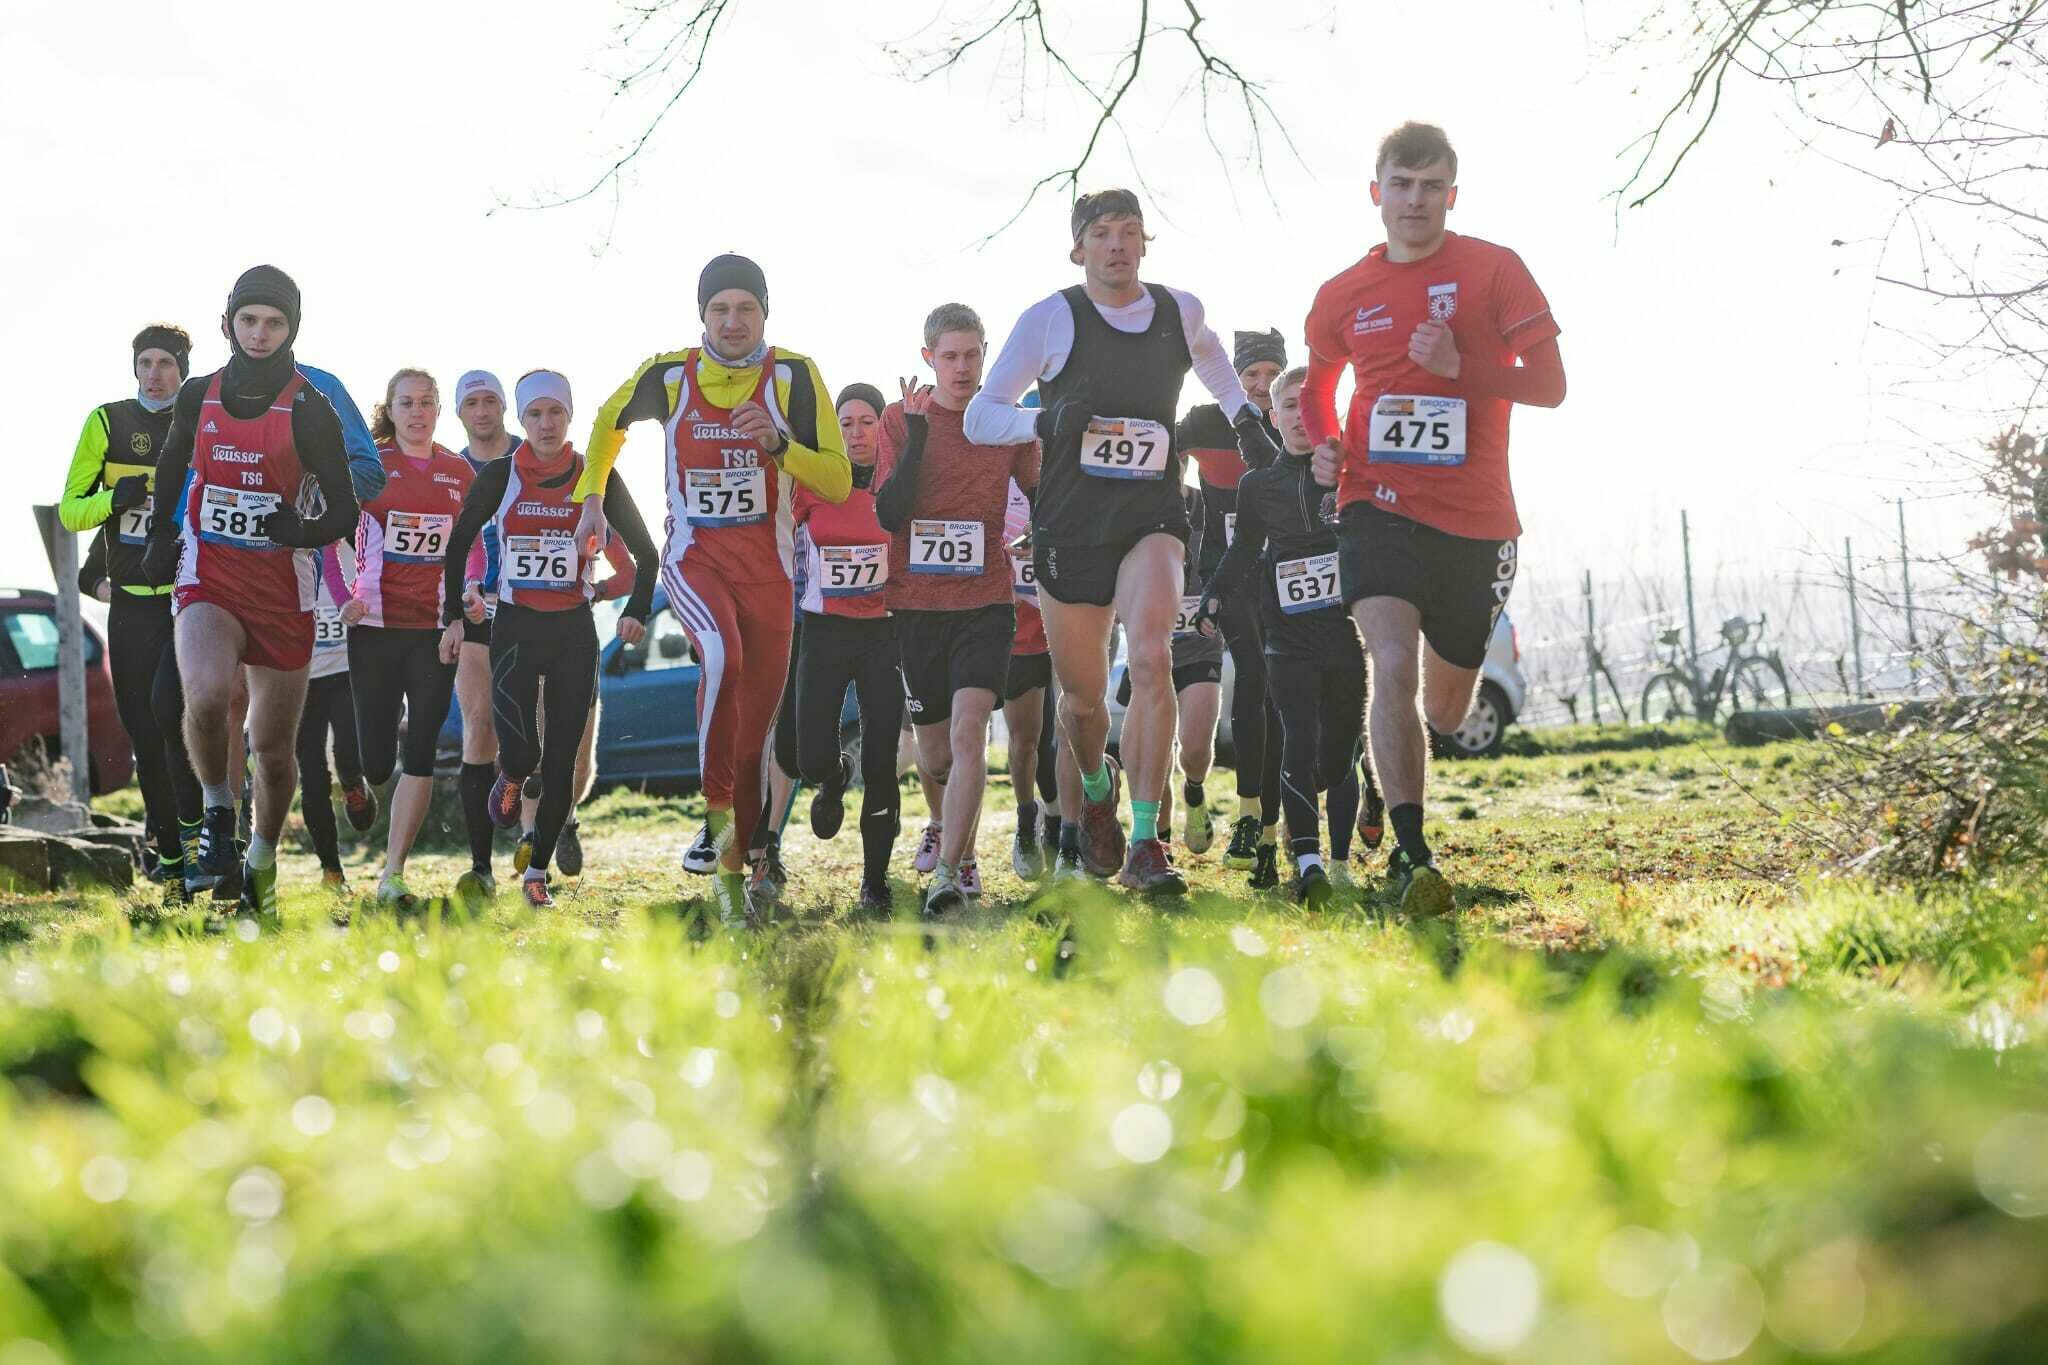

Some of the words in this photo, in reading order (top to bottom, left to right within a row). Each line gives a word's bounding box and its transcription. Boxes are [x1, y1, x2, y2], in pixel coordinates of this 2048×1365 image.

[1384, 420, 1450, 450] 475
[212, 444, 264, 464] Teusser
[721, 448, 758, 468] TSG
[1094, 439, 1155, 466] 497
[241, 471, 263, 485] TSG
[725, 470, 758, 478] BROOKS
[242, 494, 275, 503] BROOKS
[517, 501, 574, 517] Teusser
[699, 489, 754, 515] 575
[211, 508, 266, 537] 581
[949, 523, 979, 531] BROOKS
[395, 531, 442, 554] 579
[922, 540, 973, 563] 703
[516, 555, 568, 579] 576
[831, 563, 880, 586] 577
[1287, 572, 1337, 602] 637
